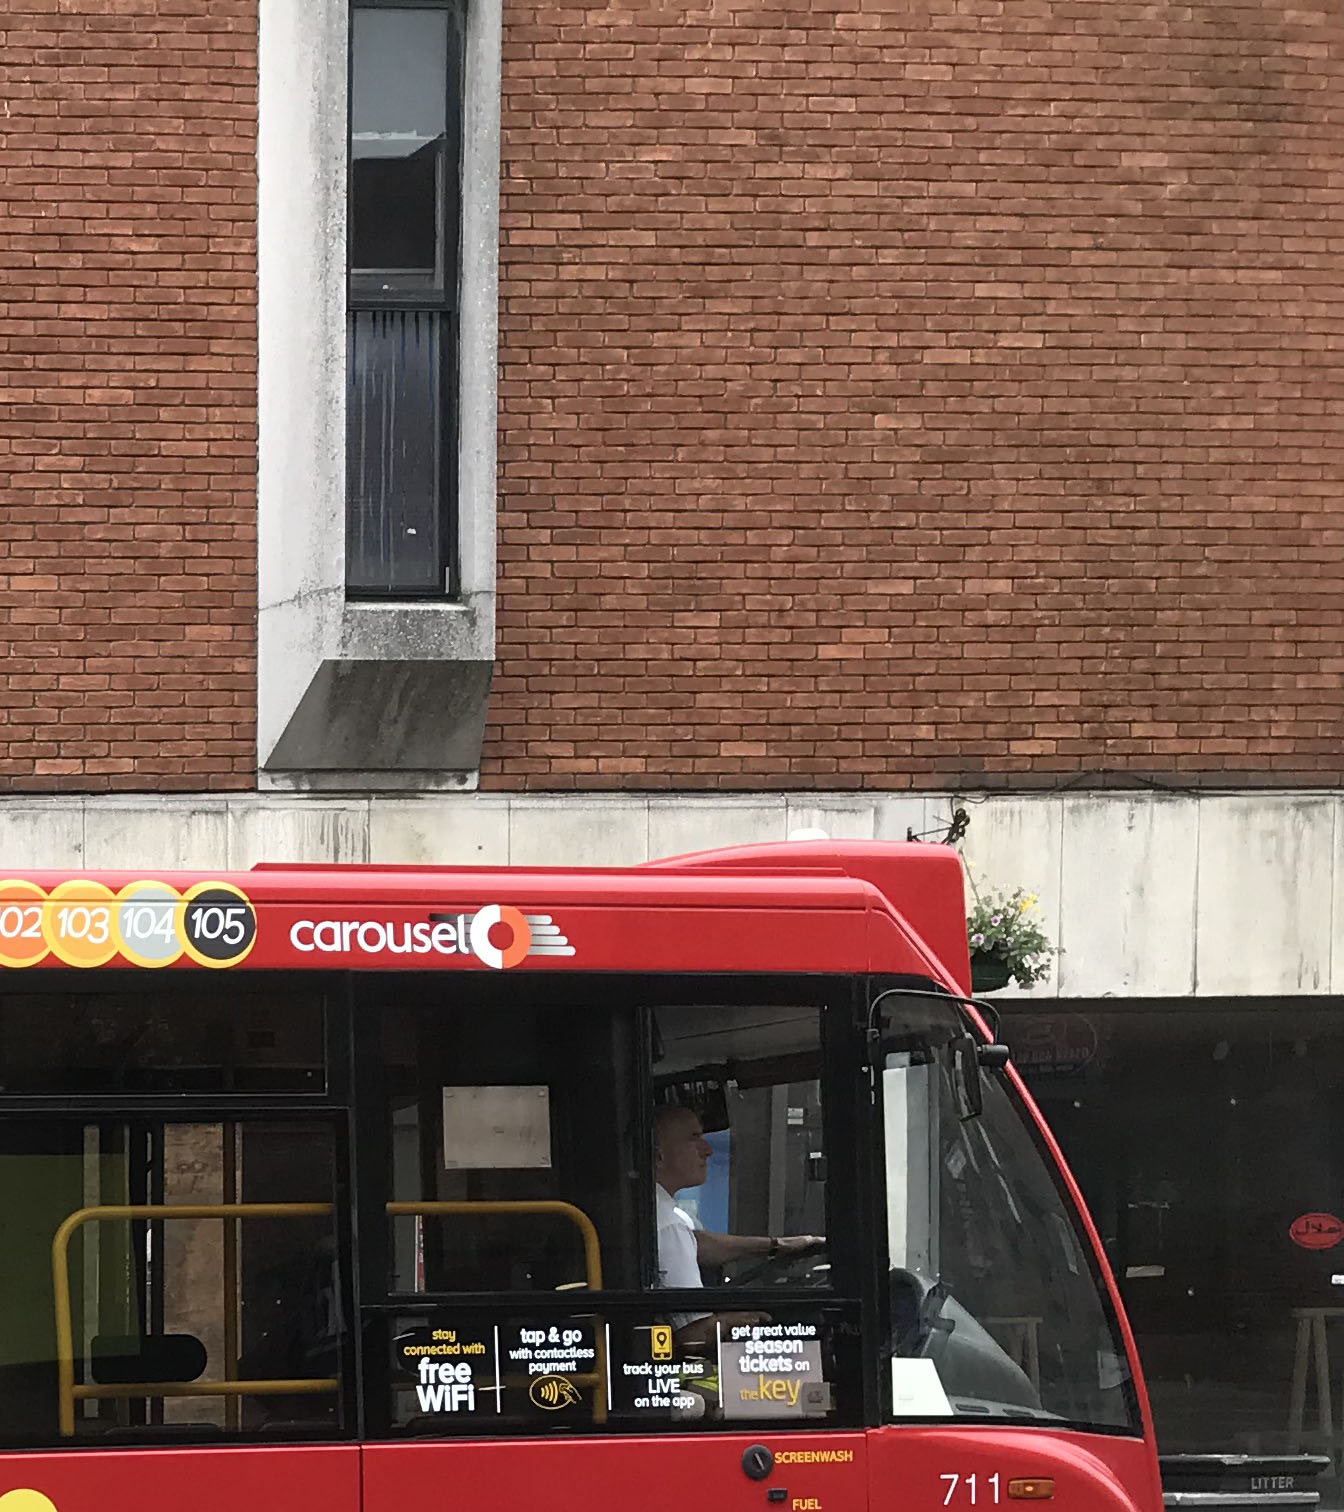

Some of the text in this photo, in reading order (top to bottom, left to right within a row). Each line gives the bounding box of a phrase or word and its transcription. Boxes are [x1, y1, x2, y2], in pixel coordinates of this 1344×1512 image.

[57, 909, 110, 944] 103
[123, 909, 176, 944] 104
[191, 907, 246, 945] 105
[289, 912, 469, 955] carousel
[432, 1329, 456, 1341] stay
[520, 1326, 582, 1346] tap & go
[731, 1323, 816, 1339] get great value
[403, 1343, 485, 1356] connected with
[509, 1346, 594, 1359] with contactless
[744, 1339, 803, 1354] season
[418, 1357, 472, 1384] free
[528, 1360, 576, 1374] payment
[623, 1362, 704, 1377] track your bus
[739, 1356, 809, 1373] tickets on
[648, 1378, 680, 1393] LIVE
[740, 1374, 801, 1406] the key
[416, 1384, 475, 1412] WiFi
[634, 1395, 695, 1409] on the app
[774, 1450, 853, 1464] SCREENWASH
[939, 1472, 999, 1506] 711
[1251, 1476, 1294, 1490] LITTER
[792, 1498, 822, 1511] FUEL
